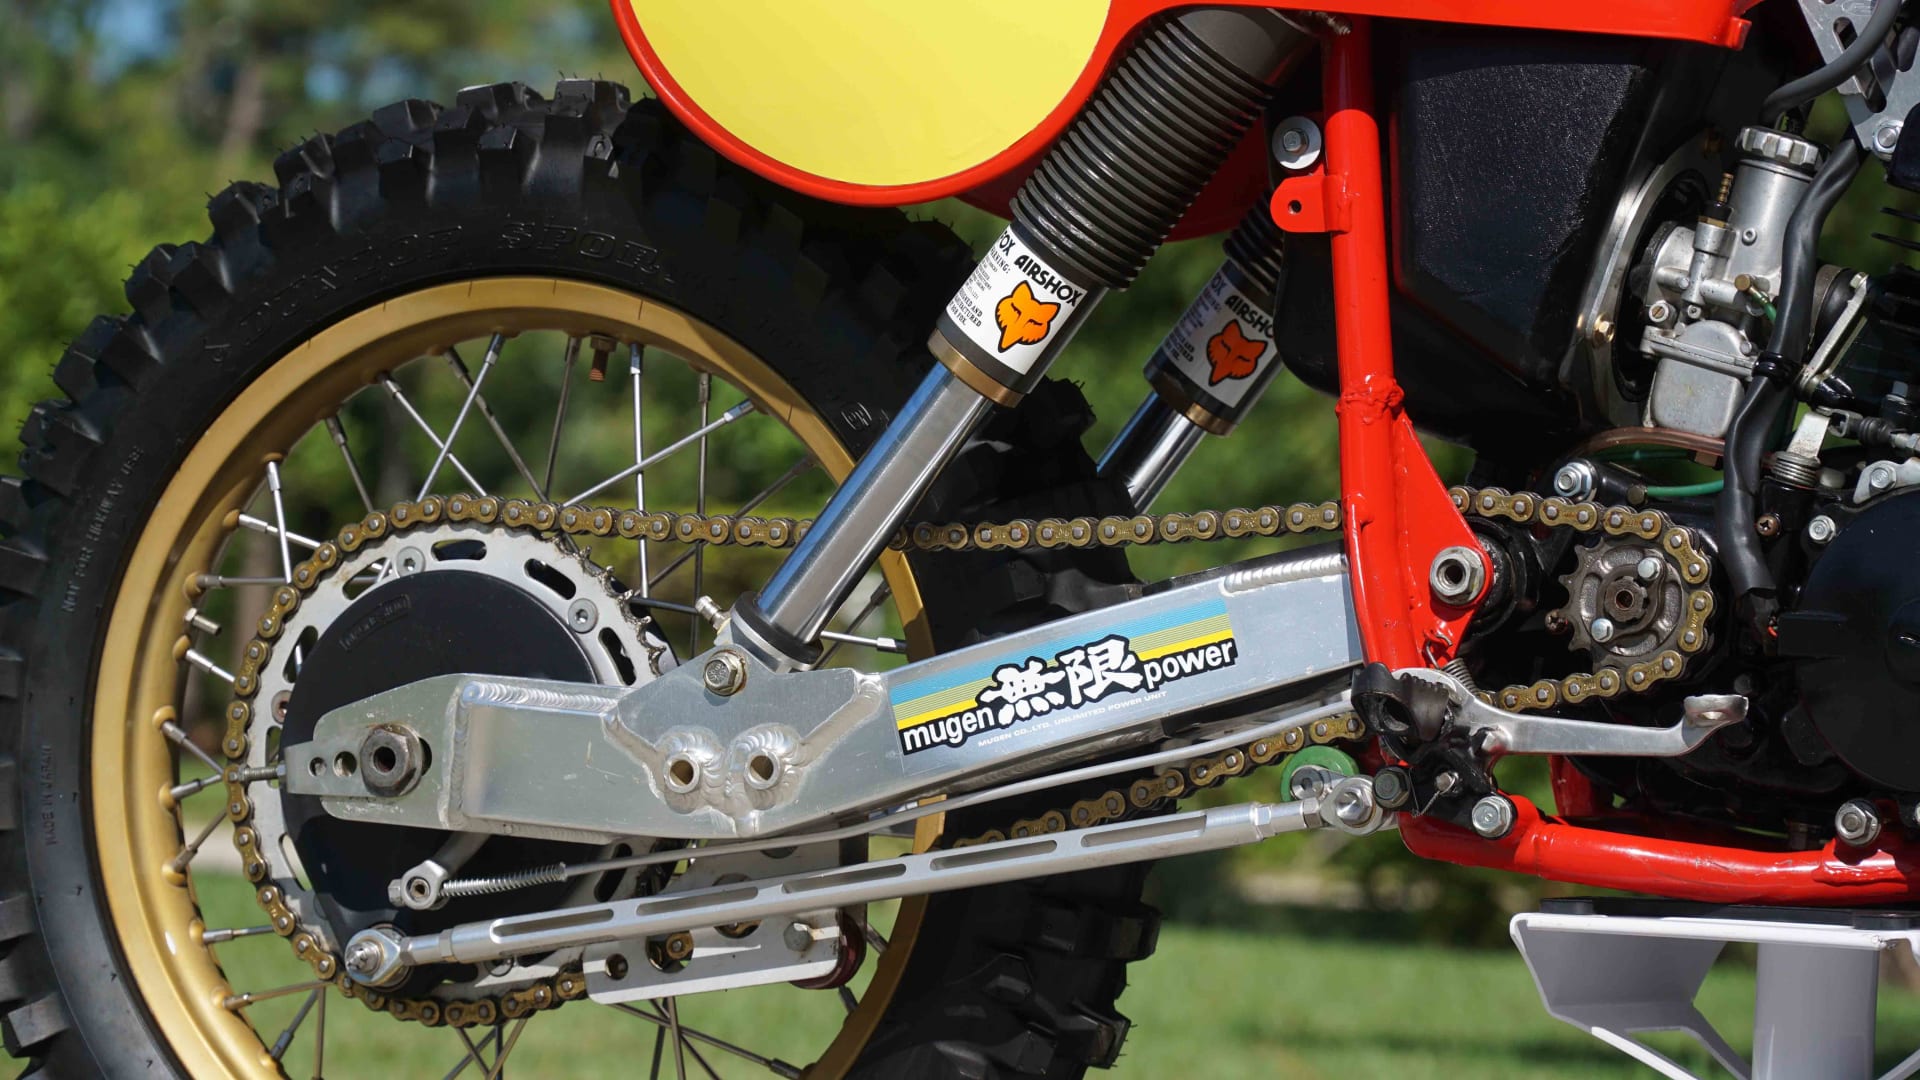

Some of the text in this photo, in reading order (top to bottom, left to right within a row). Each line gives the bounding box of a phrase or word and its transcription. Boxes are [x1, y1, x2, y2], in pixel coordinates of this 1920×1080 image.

[1014, 255, 1083, 307] AIRSHOX
[971, 304, 983, 318] AND
[1225, 295, 1274, 338] AIRSHO
[903, 638, 1233, 751] mugen 無限 power
[977, 732, 1011, 747] MUGEN
[1054, 707, 1106, 726] UNLIMITED
[1107, 697, 1141, 711] POWER
[1144, 690, 1168, 702] UNIT
